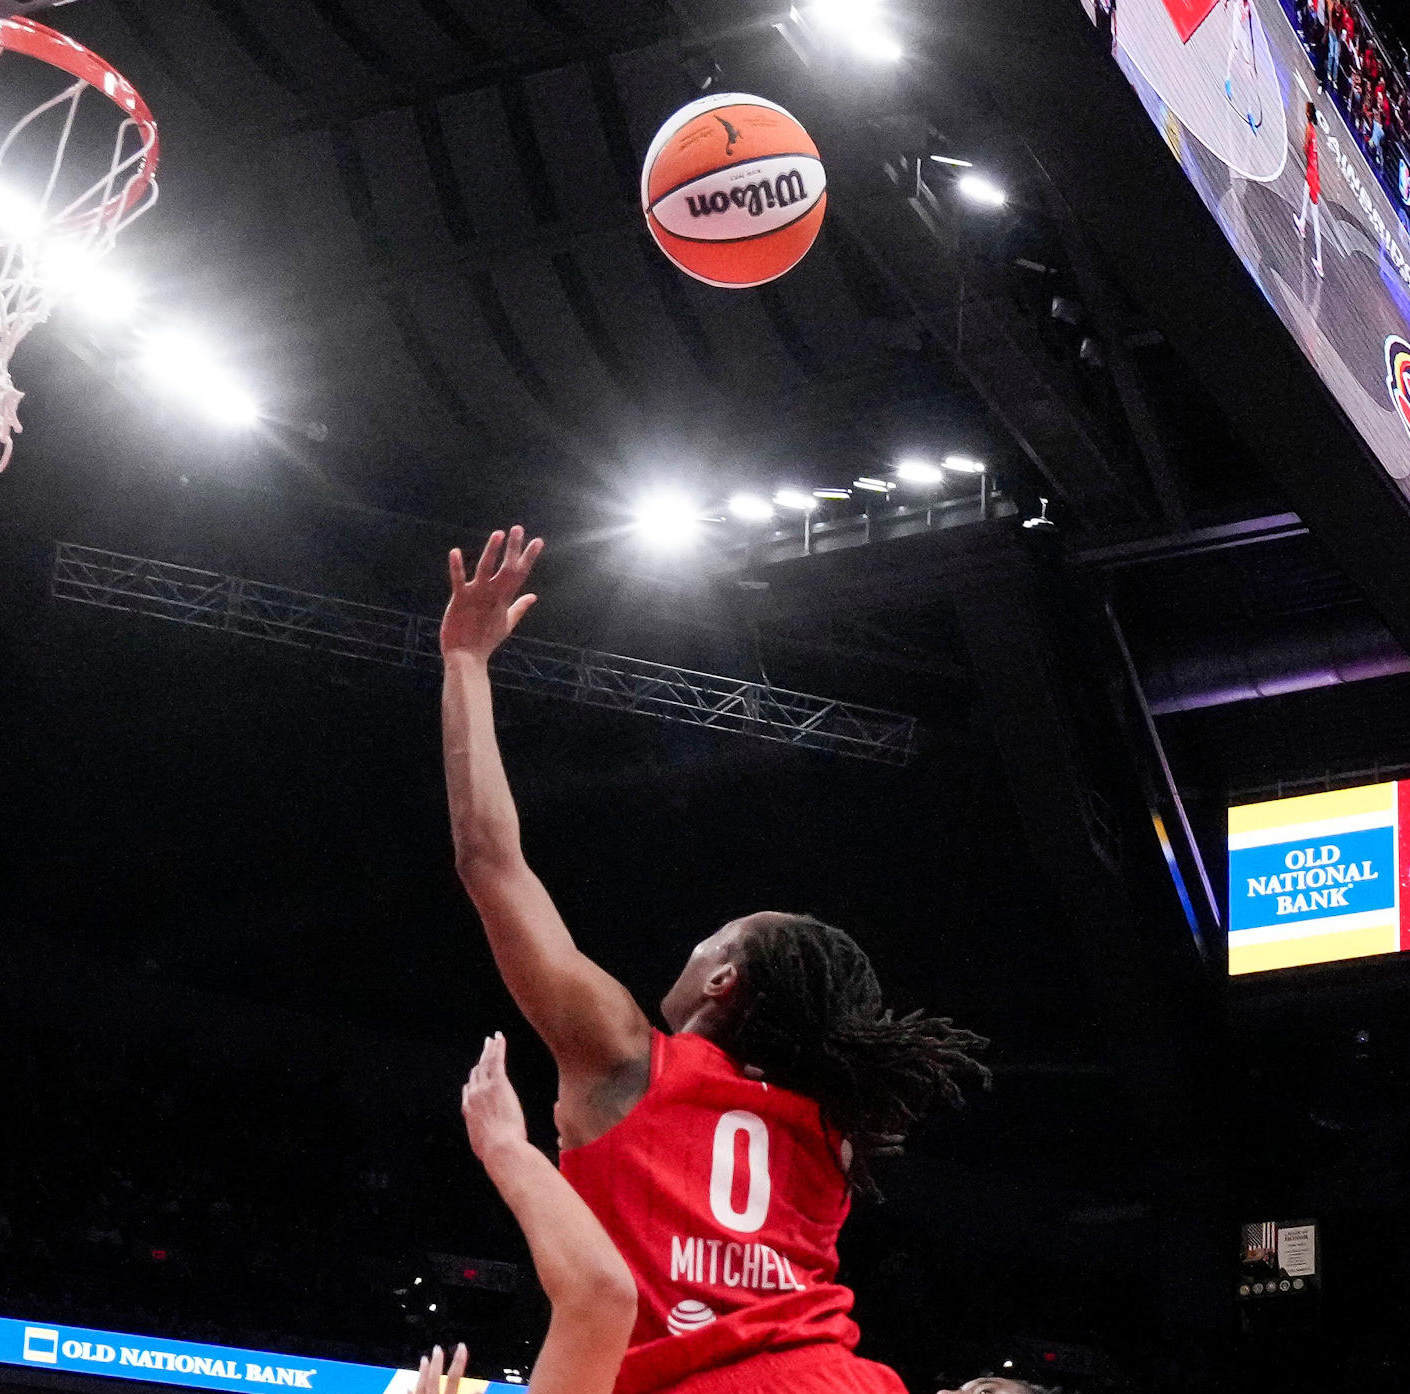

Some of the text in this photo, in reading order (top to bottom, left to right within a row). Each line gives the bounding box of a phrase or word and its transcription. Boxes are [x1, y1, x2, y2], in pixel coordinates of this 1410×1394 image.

[685, 169, 808, 217] Wilson
[1285, 845, 1341, 870] OLD
[1247, 861, 1378, 897] NATIONAL
[1276, 885, 1350, 916] BANK
[709, 1110, 771, 1233] 0
[61, 1339, 317, 1390] OLD NATIONAL BANK
